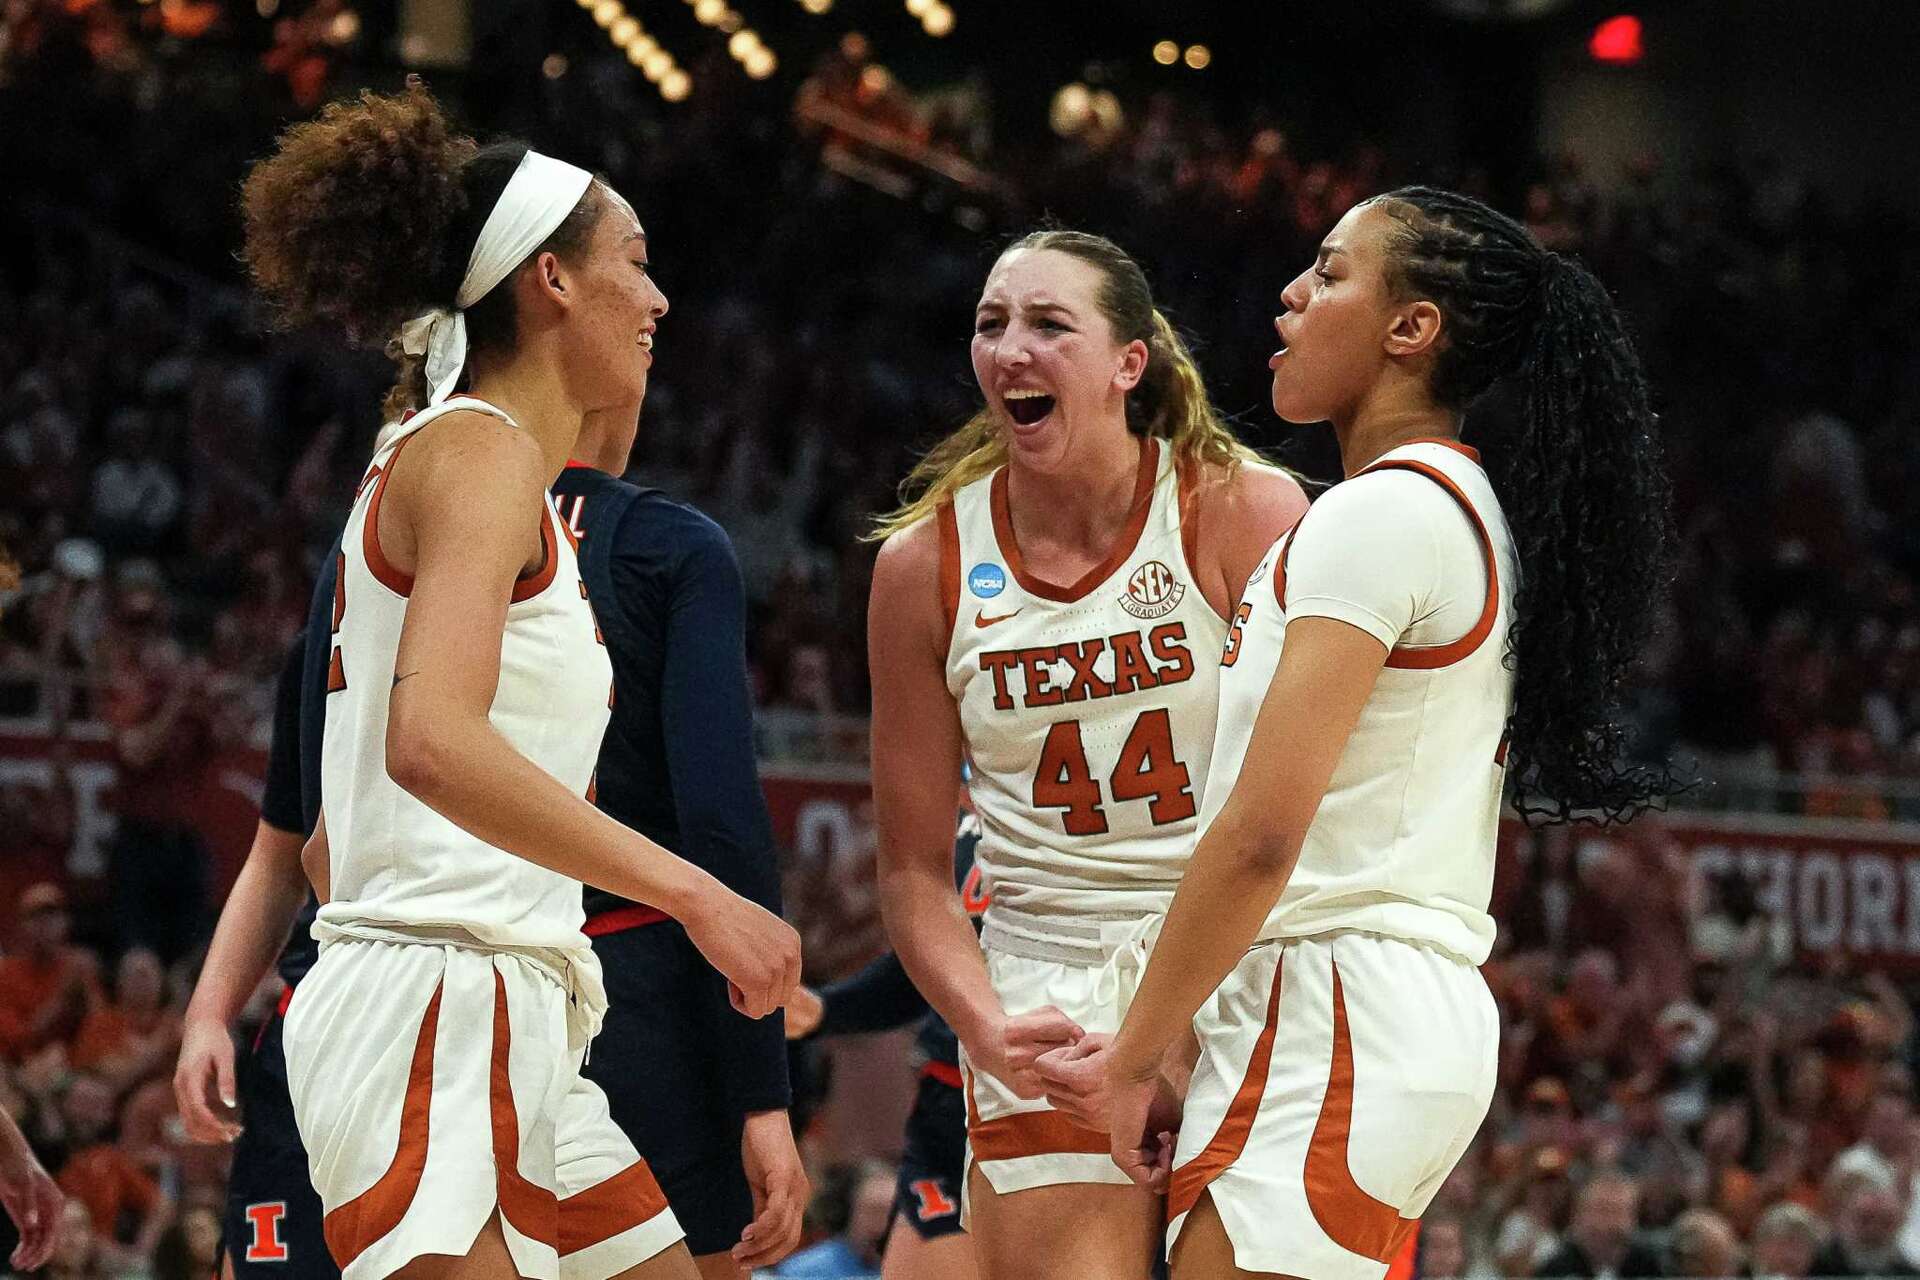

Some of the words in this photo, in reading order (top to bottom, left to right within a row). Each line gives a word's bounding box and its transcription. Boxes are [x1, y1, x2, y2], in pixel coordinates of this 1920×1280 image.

[1126, 595, 1179, 618] GRADUATE
[1129, 562, 1174, 603] SEC
[979, 621, 1195, 711] TEXAS
[1032, 707, 1197, 837] 44
[246, 1201, 288, 1262] I
